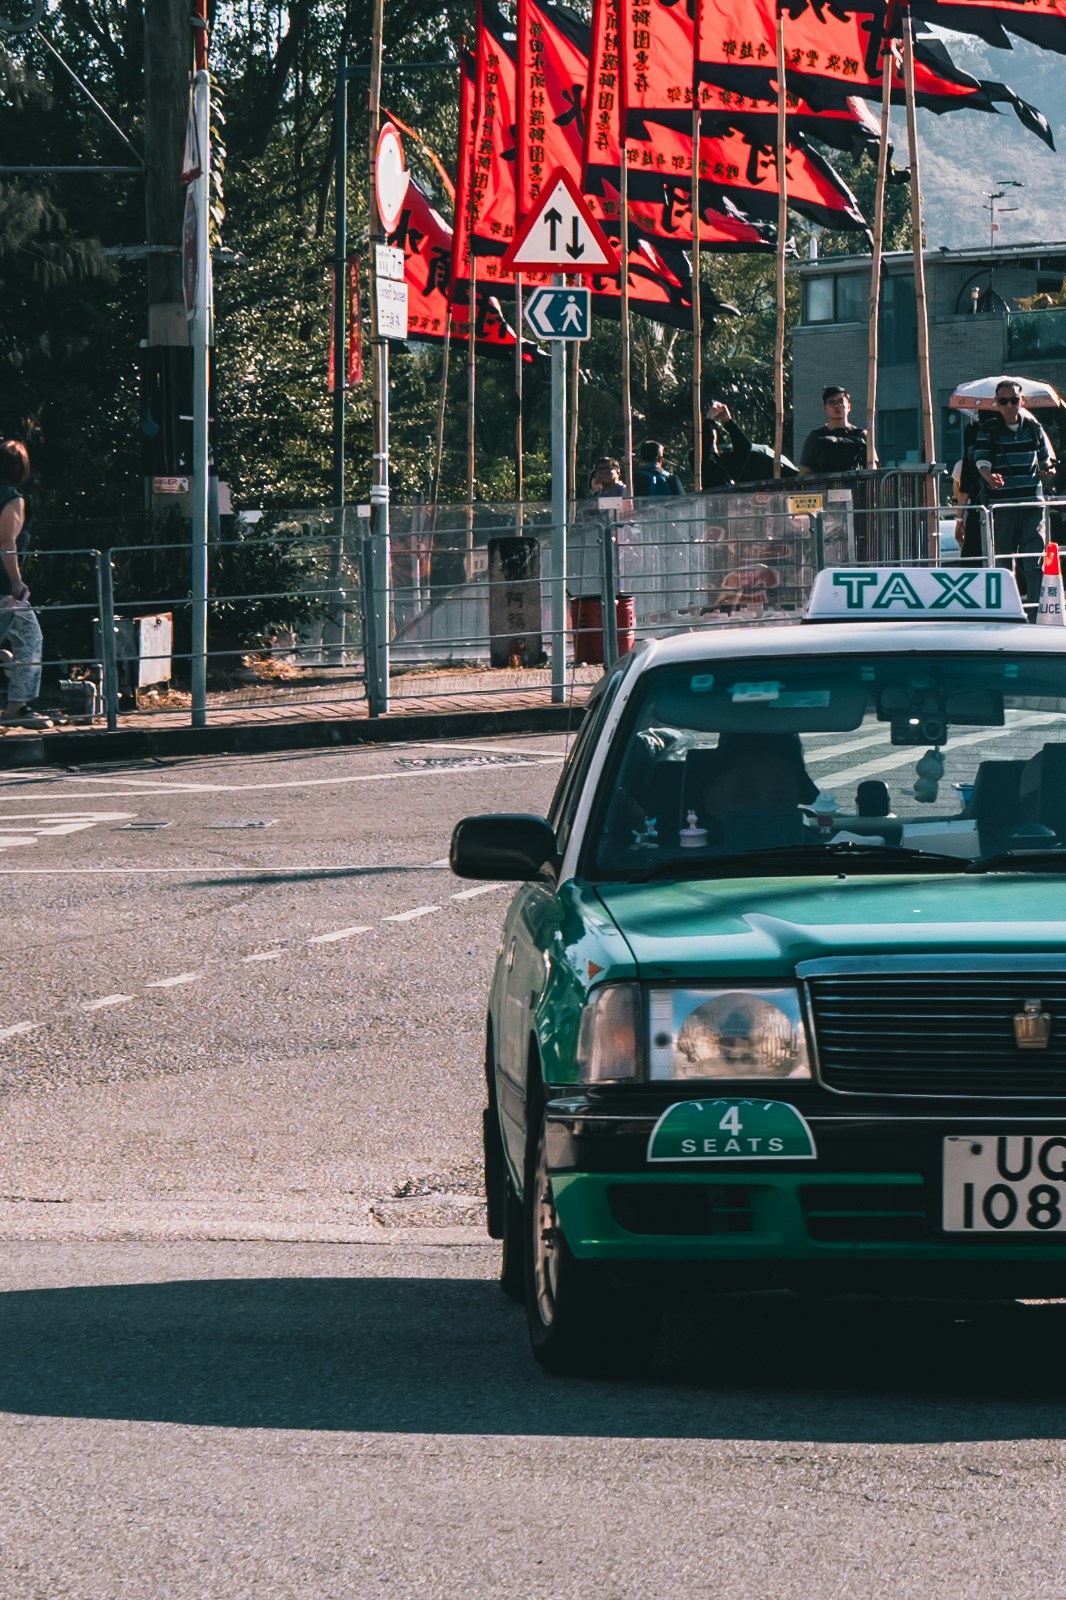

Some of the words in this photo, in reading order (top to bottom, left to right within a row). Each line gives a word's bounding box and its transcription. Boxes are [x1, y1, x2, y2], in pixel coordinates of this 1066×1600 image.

[832, 572, 1002, 609] TAXI
[719, 1105, 743, 1136] 4
[681, 1137, 784, 1153] SEATS
